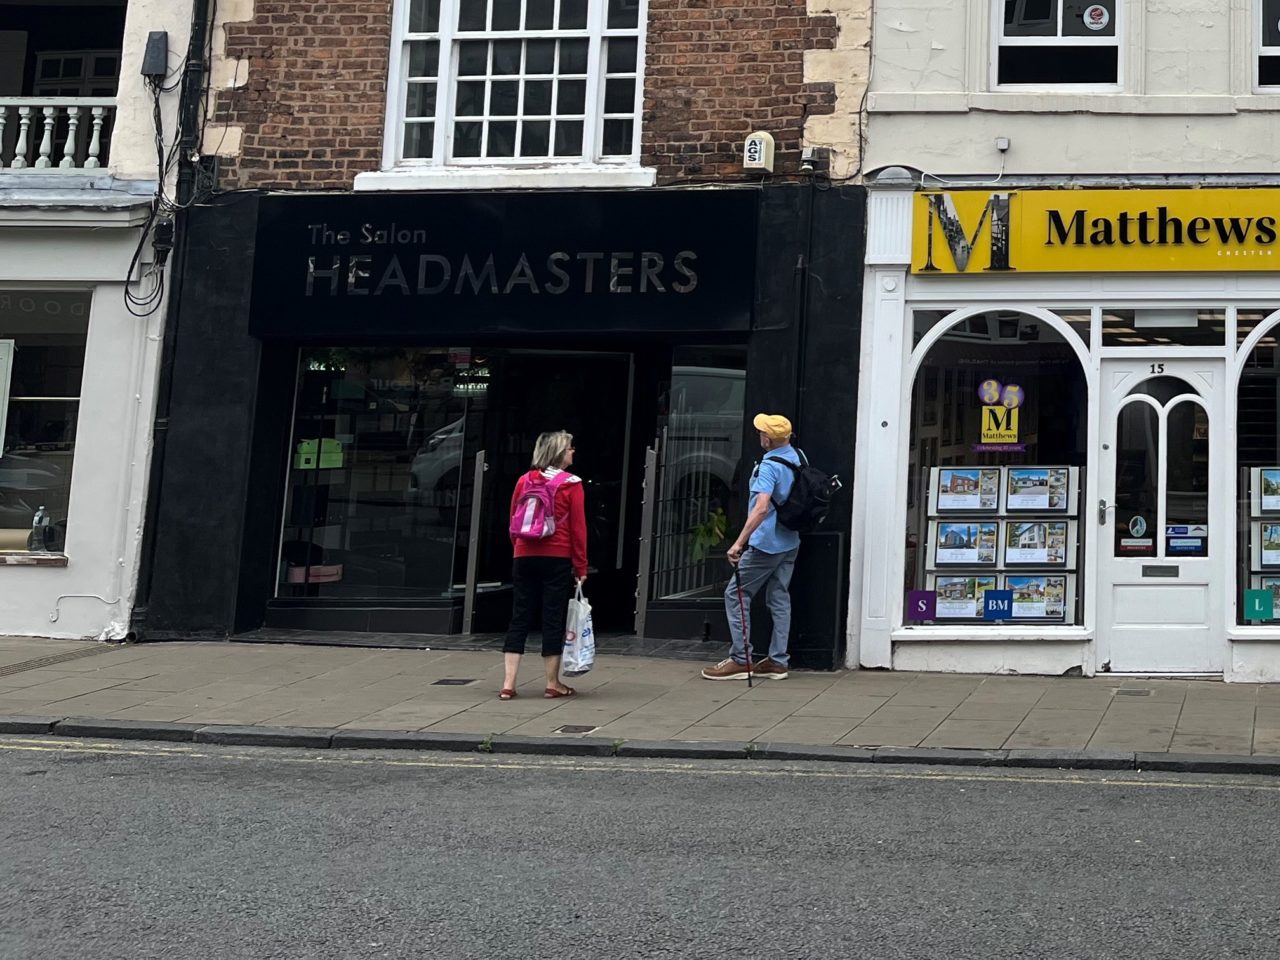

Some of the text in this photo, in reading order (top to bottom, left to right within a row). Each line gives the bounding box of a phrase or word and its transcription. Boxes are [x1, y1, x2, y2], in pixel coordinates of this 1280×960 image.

[747, 139, 758, 162] AGS
[308, 222, 427, 245] The Salon
[918, 192, 1018, 272] M
[1044, 206, 1278, 246] Matthews
[1217, 249, 1273, 257] CHESTER
[305, 250, 699, 297] HEADMASTERS
[1149, 363, 1165, 374] 15
[982, 380, 1020, 408] 35
[986, 407, 1013, 431] M
[982, 432, 1017, 440] Matthews
[917, 599, 927, 612] S
[988, 599, 1008, 611] BM
[1254, 598, 1264, 611] L
